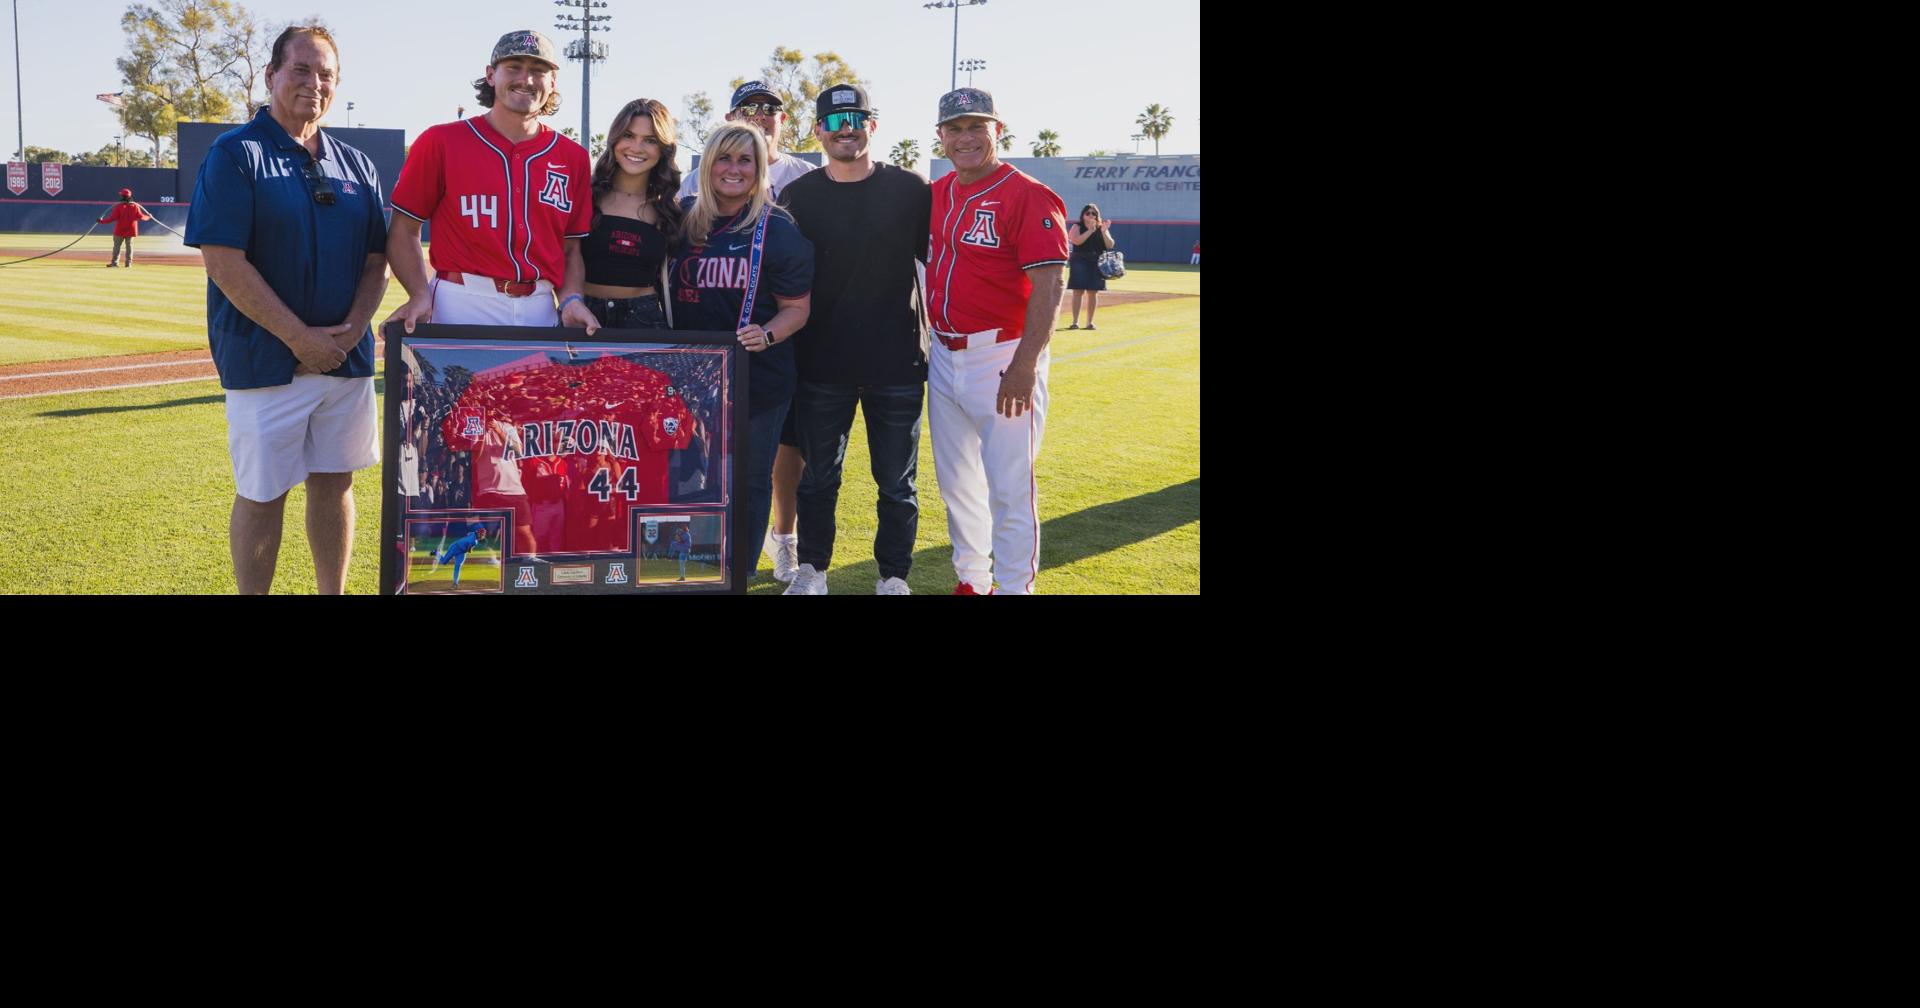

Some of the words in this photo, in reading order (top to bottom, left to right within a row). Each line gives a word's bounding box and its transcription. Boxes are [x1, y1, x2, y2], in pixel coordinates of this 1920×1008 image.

[10, 177, 25, 188] 1986
[1074, 166, 1129, 178] TERRY
[45, 178, 60, 189] 2012
[539, 170, 572, 213] A
[1097, 182, 1150, 191] HITTING
[461, 195, 498, 228] 44
[960, 208, 1000, 249] A
[503, 420, 640, 461] ARIZONA
[588, 467, 640, 503] 44
[515, 566, 538, 588] A
[605, 562, 628, 584] A
